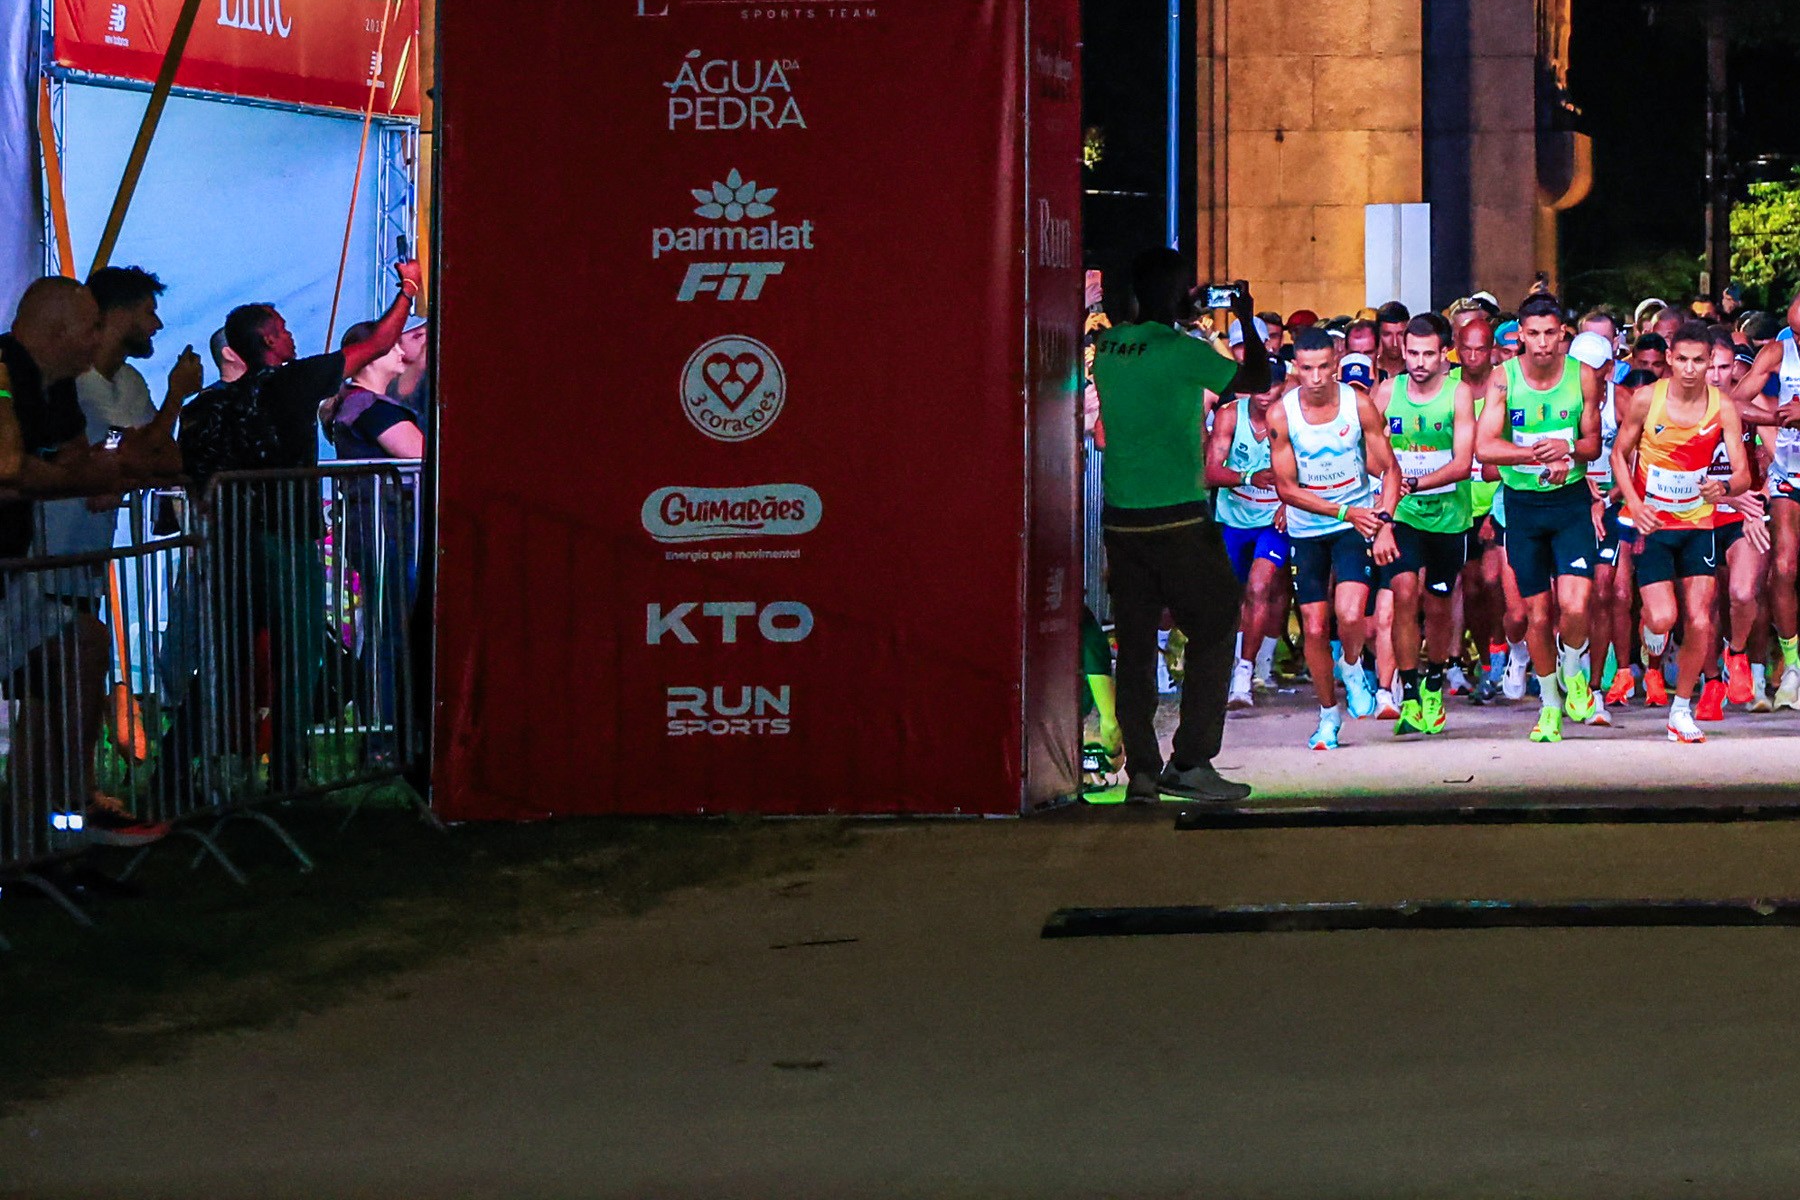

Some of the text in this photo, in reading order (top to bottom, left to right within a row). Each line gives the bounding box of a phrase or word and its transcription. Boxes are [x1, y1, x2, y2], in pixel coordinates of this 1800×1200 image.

[741, 8, 877, 19] SPORTS TEAM
[664, 49, 791, 94] ÁGUA
[668, 97, 808, 131] PEDRA
[652, 220, 815, 259] parmalat
[1100, 340, 1147, 357] STAFF
[690, 389, 777, 433] 3 corações
[1307, 471, 1346, 483] JOHNATAS
[665, 550, 709, 562] Energia
[711, 551, 733, 561] que
[646, 601, 814, 645] KTO
[667, 685, 790, 718] RUN
[667, 718, 791, 737] SPORTS
